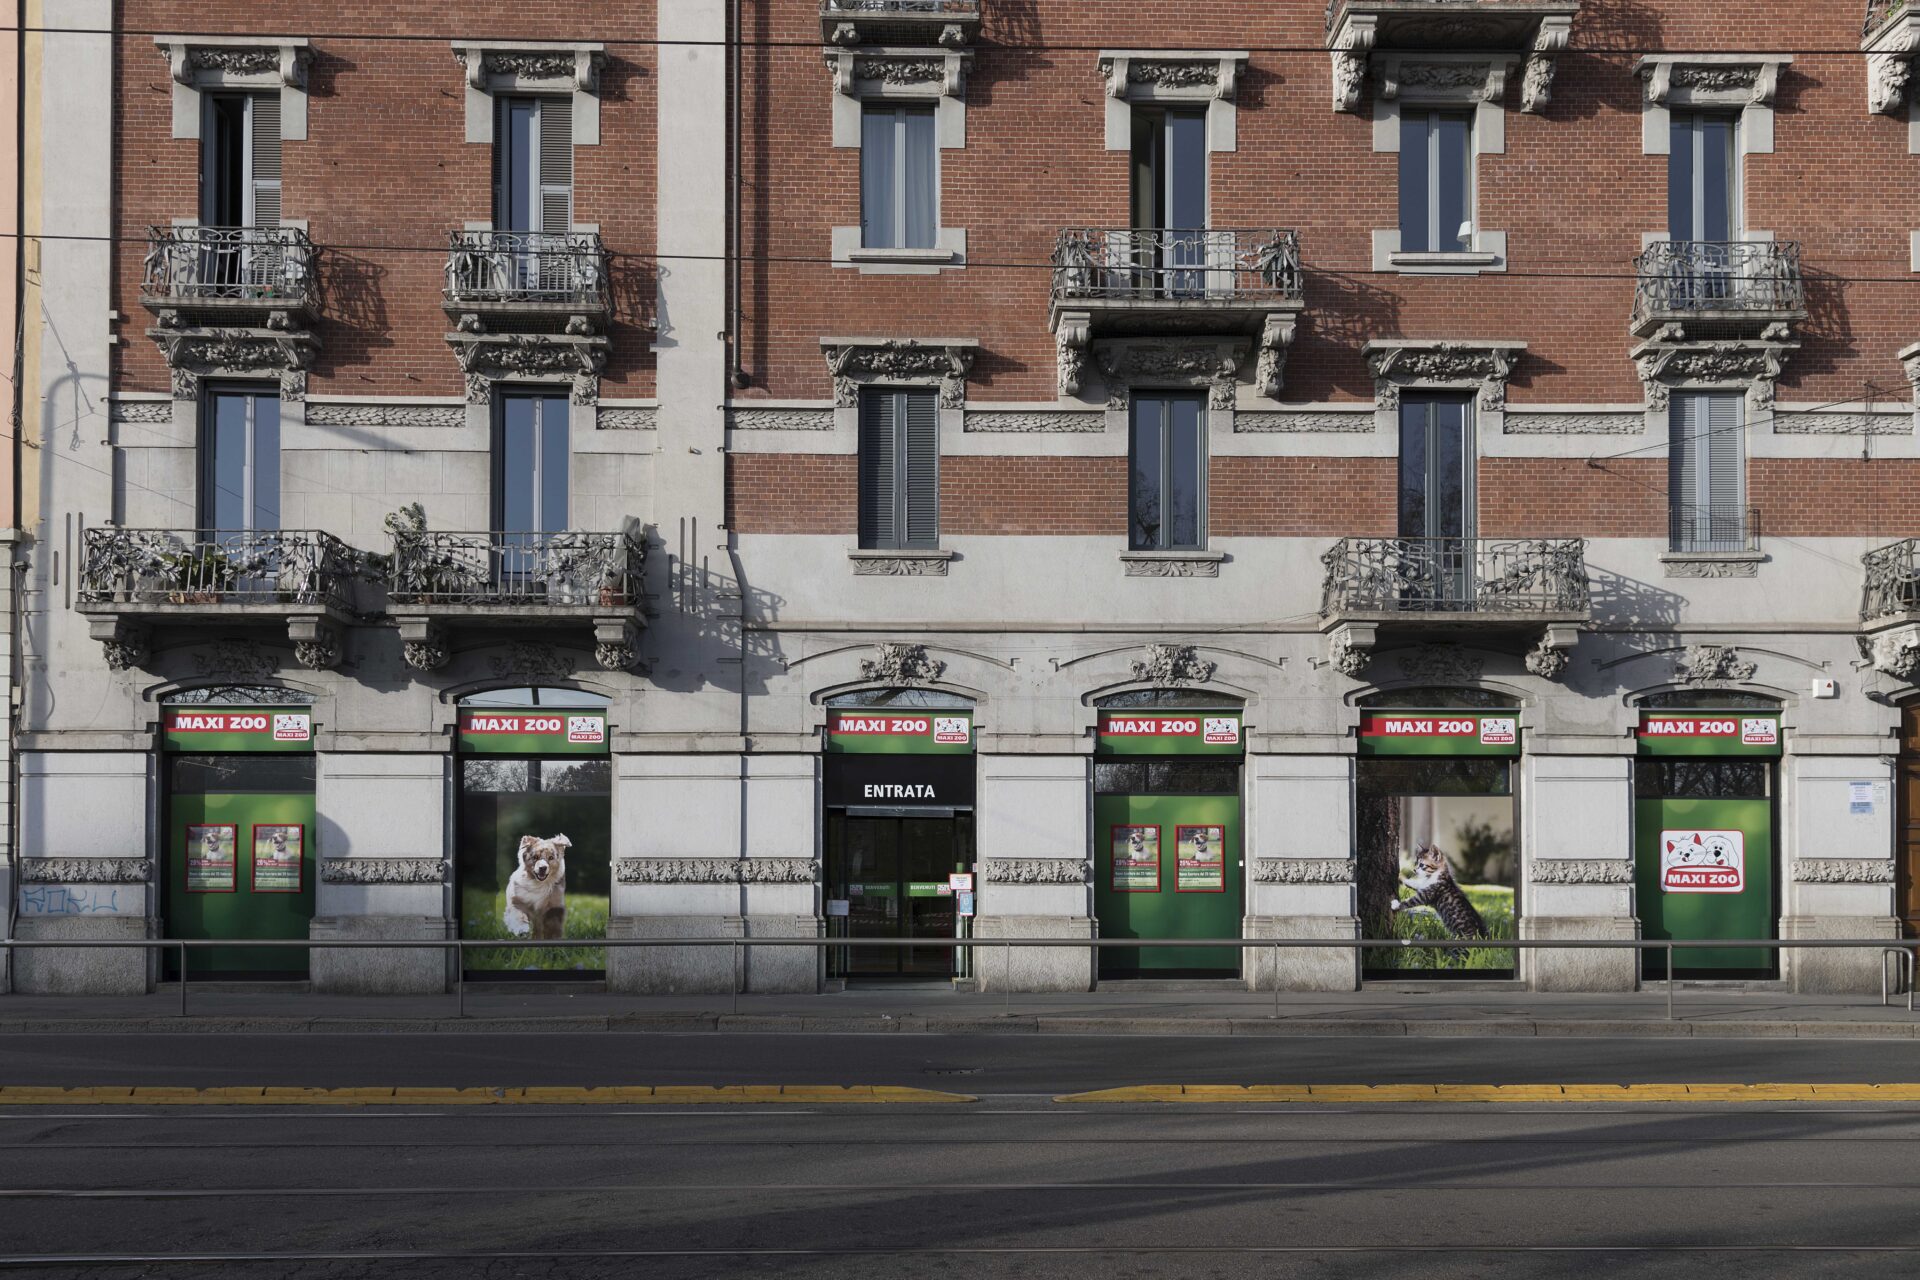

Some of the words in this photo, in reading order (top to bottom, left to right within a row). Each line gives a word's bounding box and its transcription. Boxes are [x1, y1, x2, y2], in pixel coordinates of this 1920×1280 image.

[176, 717, 224, 729] MAXI
[229, 717, 267, 729] ZOO
[471, 718, 519, 731] MAXI
[524, 718, 561, 731] ZOO
[839, 719, 886, 732] MAXI
[891, 719, 927, 732] ZOO
[1109, 720, 1156, 733] MAXI
[1161, 720, 1197, 733] ZOO
[1385, 721, 1433, 733] MAXI
[1438, 721, 1474, 733] ZOO
[1647, 721, 1694, 733] MAXI
[1699, 721, 1735, 733] ZOO
[864, 784, 936, 798] ENTRATA
[1667, 874, 1706, 884] MAXI
[1709, 874, 1738, 884] ZOO
